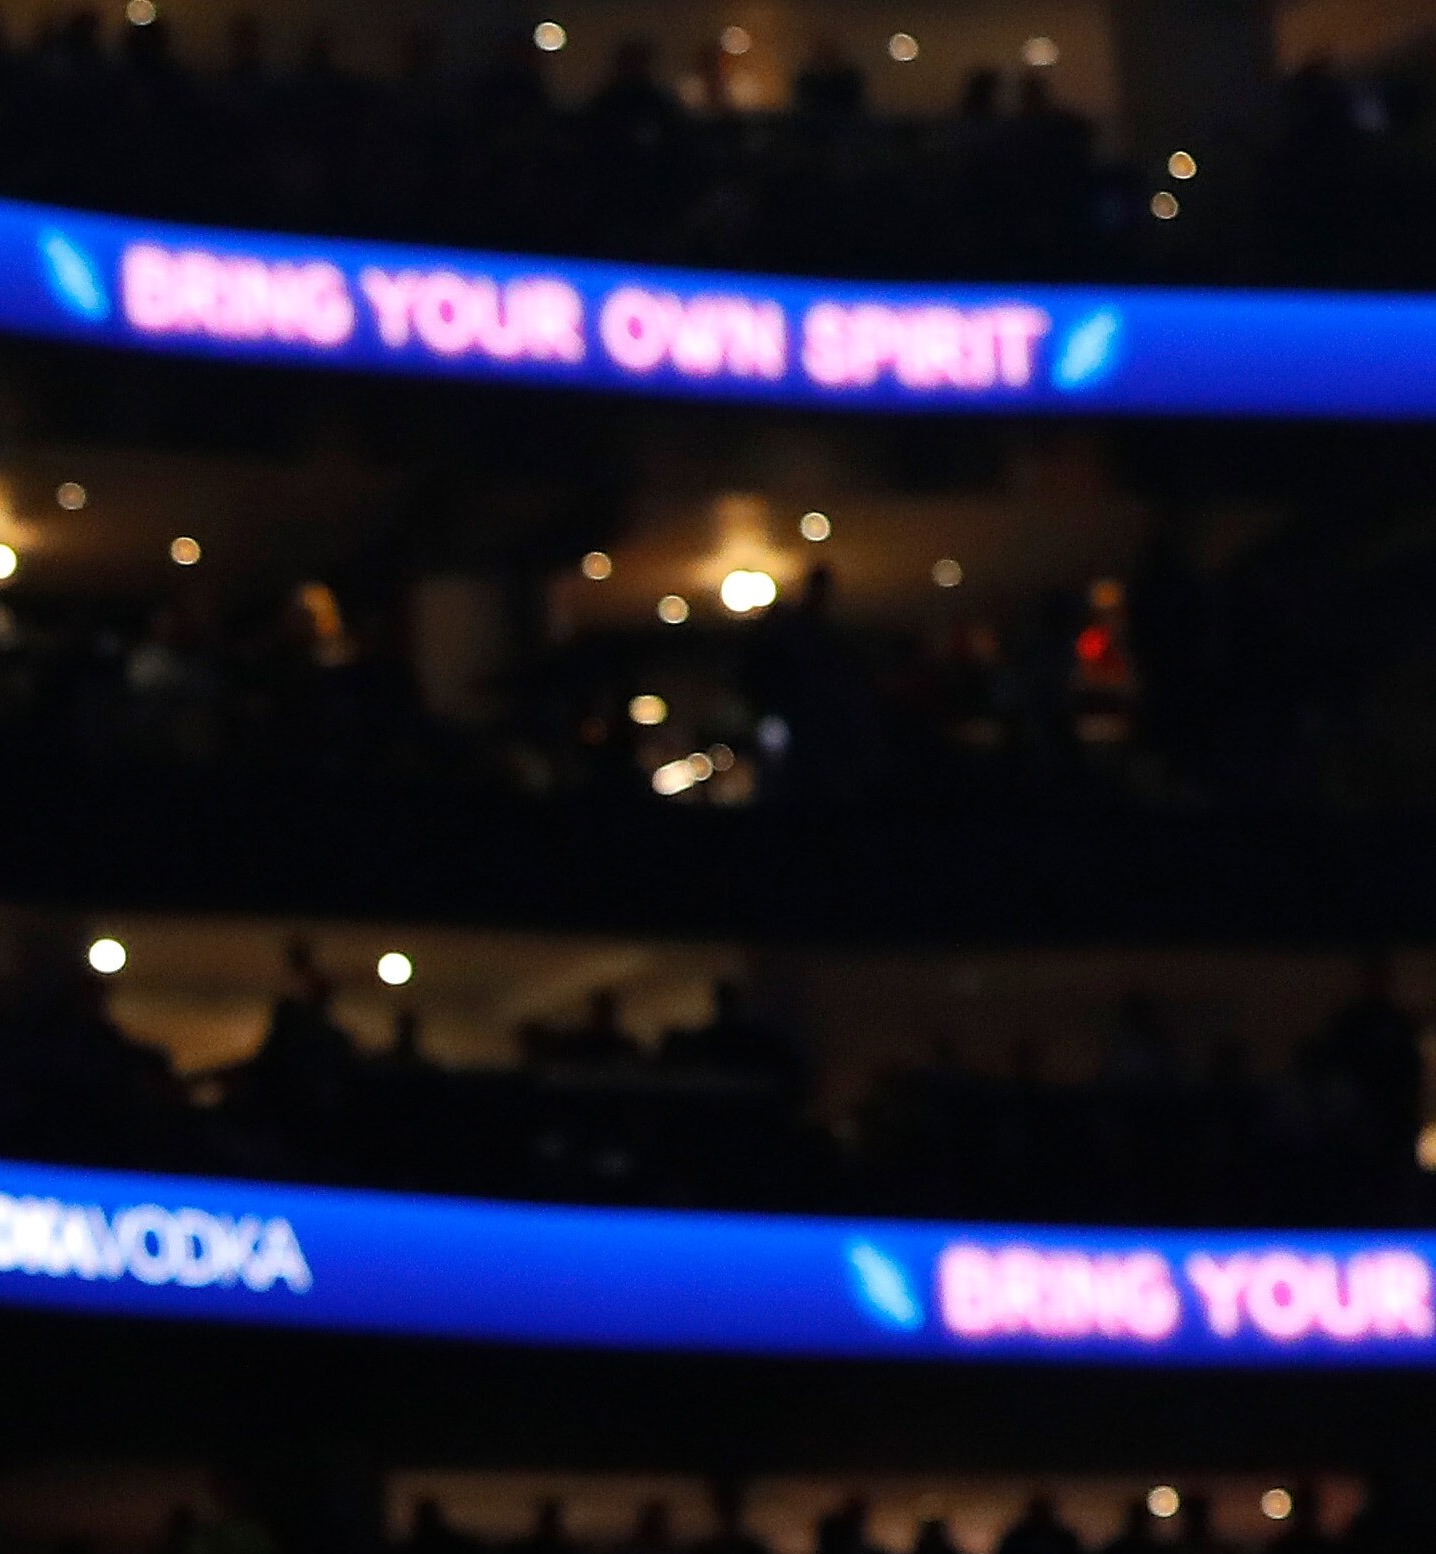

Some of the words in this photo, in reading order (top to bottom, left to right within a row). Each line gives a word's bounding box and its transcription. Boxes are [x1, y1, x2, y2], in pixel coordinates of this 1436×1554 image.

[362, 268, 584, 361] YOUR
[601, 286, 786, 381] OWN
[803, 300, 1049, 387] SPIRIT
[1184, 1249, 1433, 1342] YOUR
